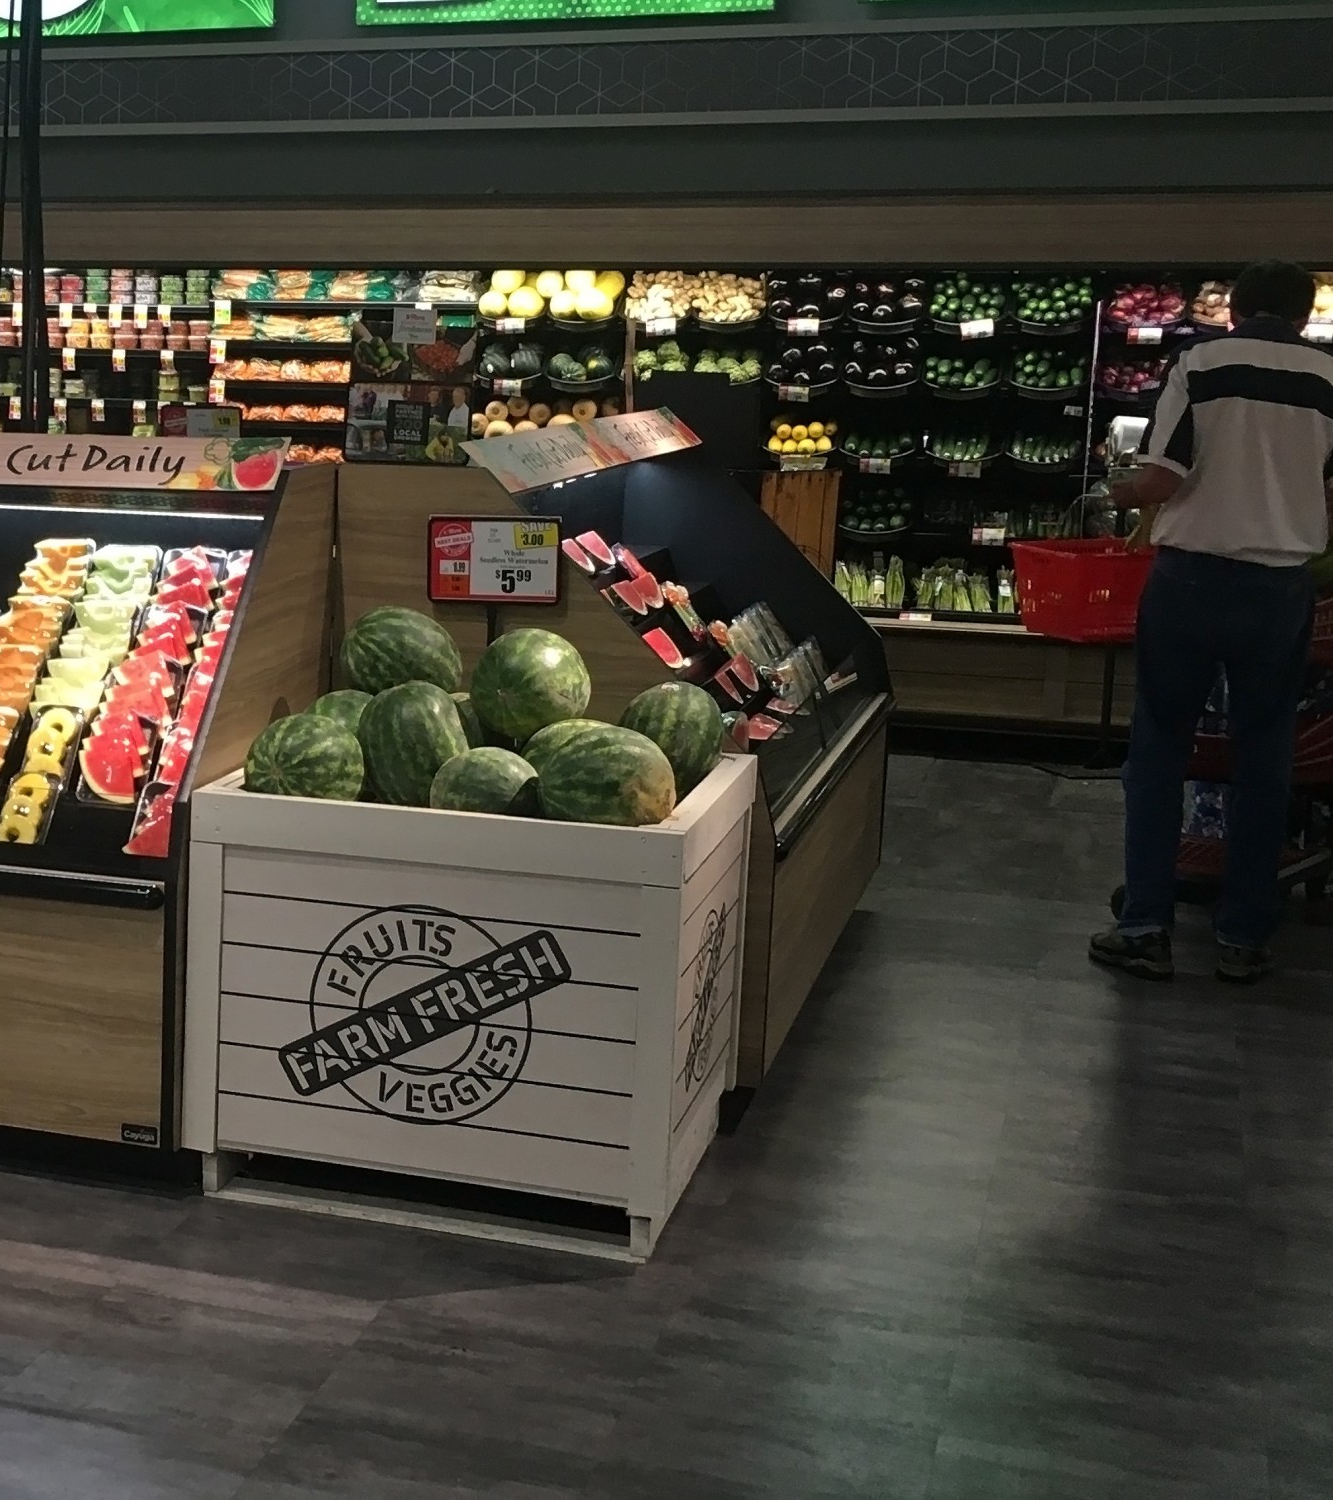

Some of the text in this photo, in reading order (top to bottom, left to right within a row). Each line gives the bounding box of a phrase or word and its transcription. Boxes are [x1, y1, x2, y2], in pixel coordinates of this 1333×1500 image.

[394, 429, 422, 437] LOCAL
[7, 440, 78, 475] Cut
[82, 445, 186, 485] Daily
[521, 522, 551, 533] SAVE
[508, 557, 549, 565] Watermelon
[327, 919, 456, 997] FRUITS
[286, 938, 564, 1090] FARM FRESH
[378, 1031, 517, 1114] VEGGIES
